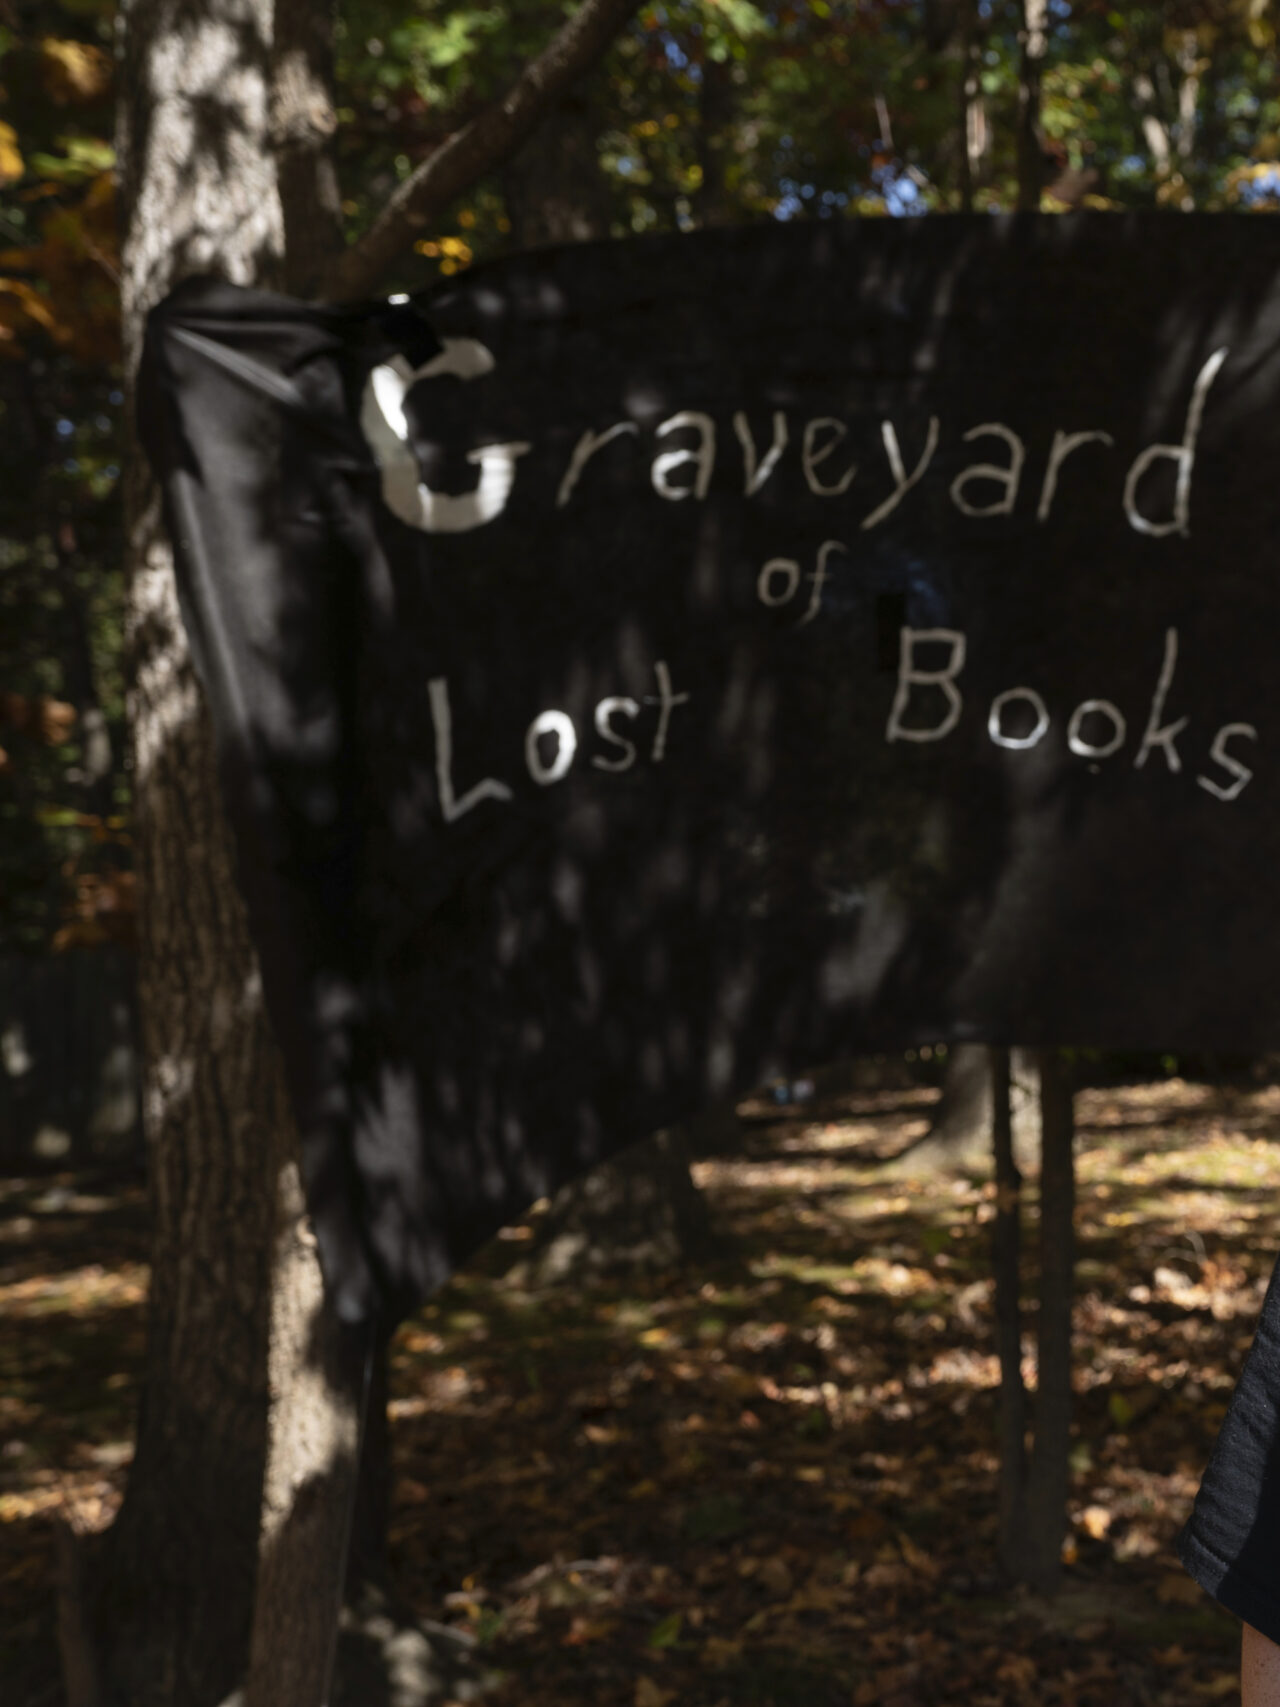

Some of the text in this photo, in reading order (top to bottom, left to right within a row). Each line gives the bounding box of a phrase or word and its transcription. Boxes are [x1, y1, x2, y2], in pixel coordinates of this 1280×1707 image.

[361, 338, 1228, 537] Graveyard
[757, 540, 848, 625] of
[428, 626, 1258, 822] Lost Books
